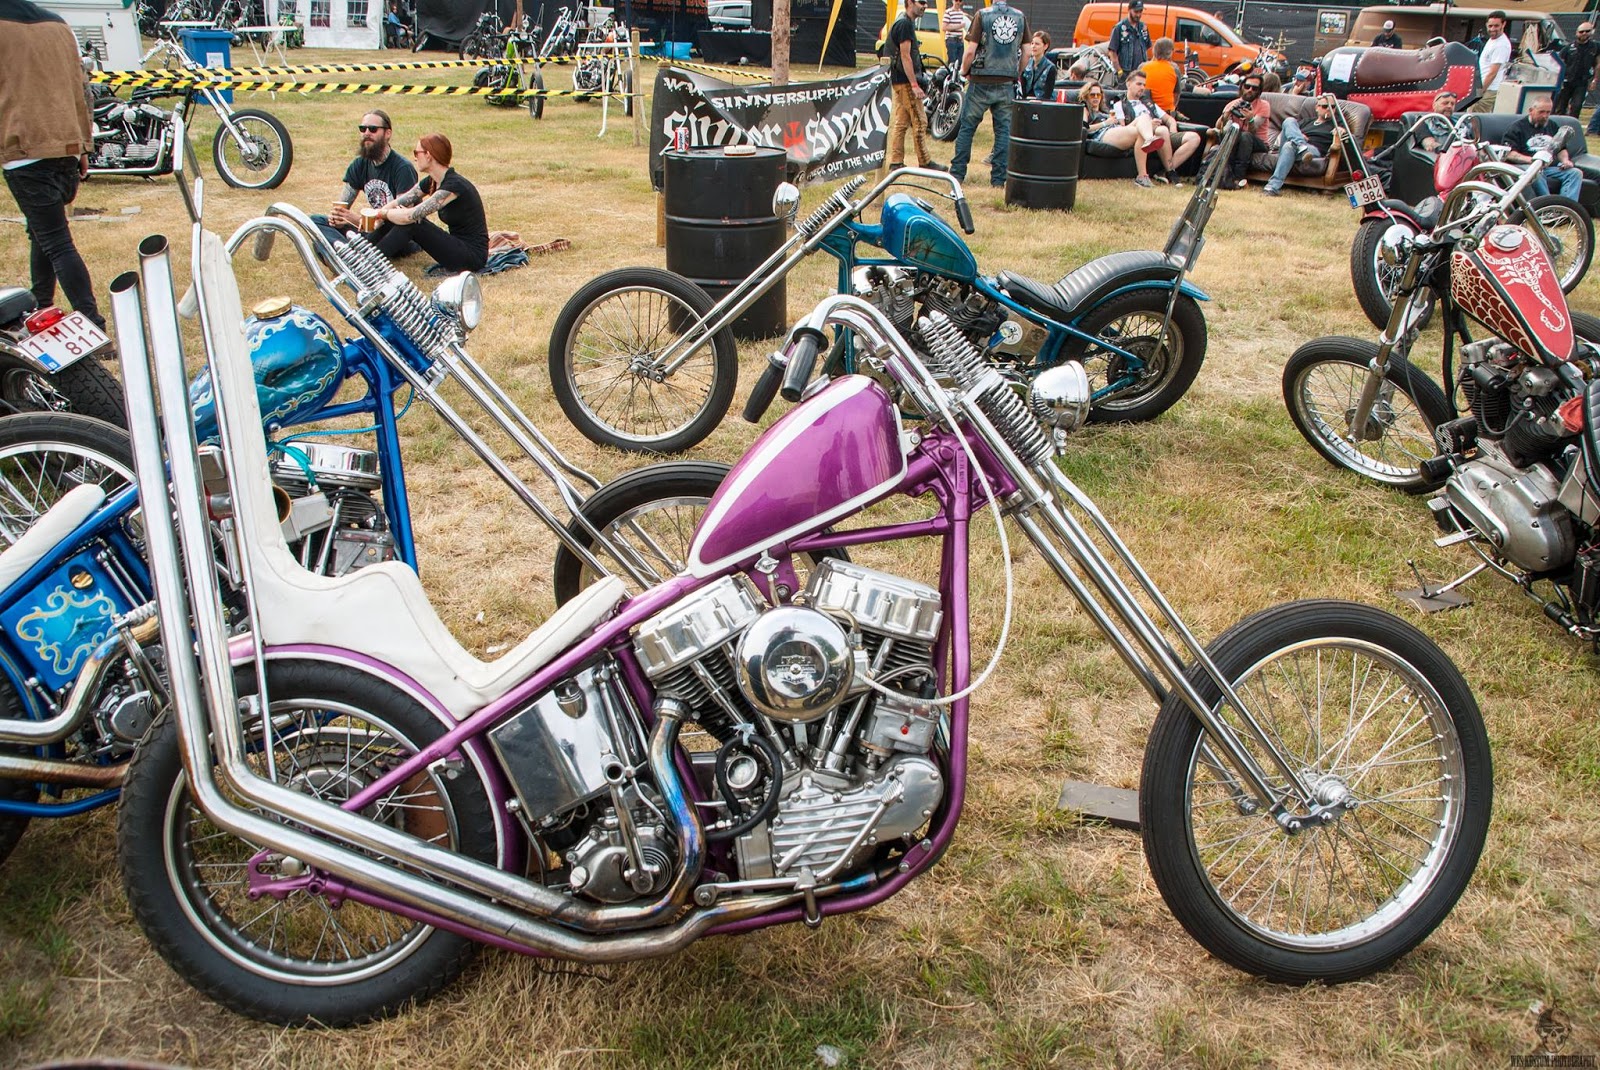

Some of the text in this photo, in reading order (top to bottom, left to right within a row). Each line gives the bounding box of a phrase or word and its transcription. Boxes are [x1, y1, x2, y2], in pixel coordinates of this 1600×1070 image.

[827, 160, 844, 174] OUT
[844, 156, 862, 169] THE
[1363, 189, 1382, 202] 984
[64, 329, 103, 355] 811
